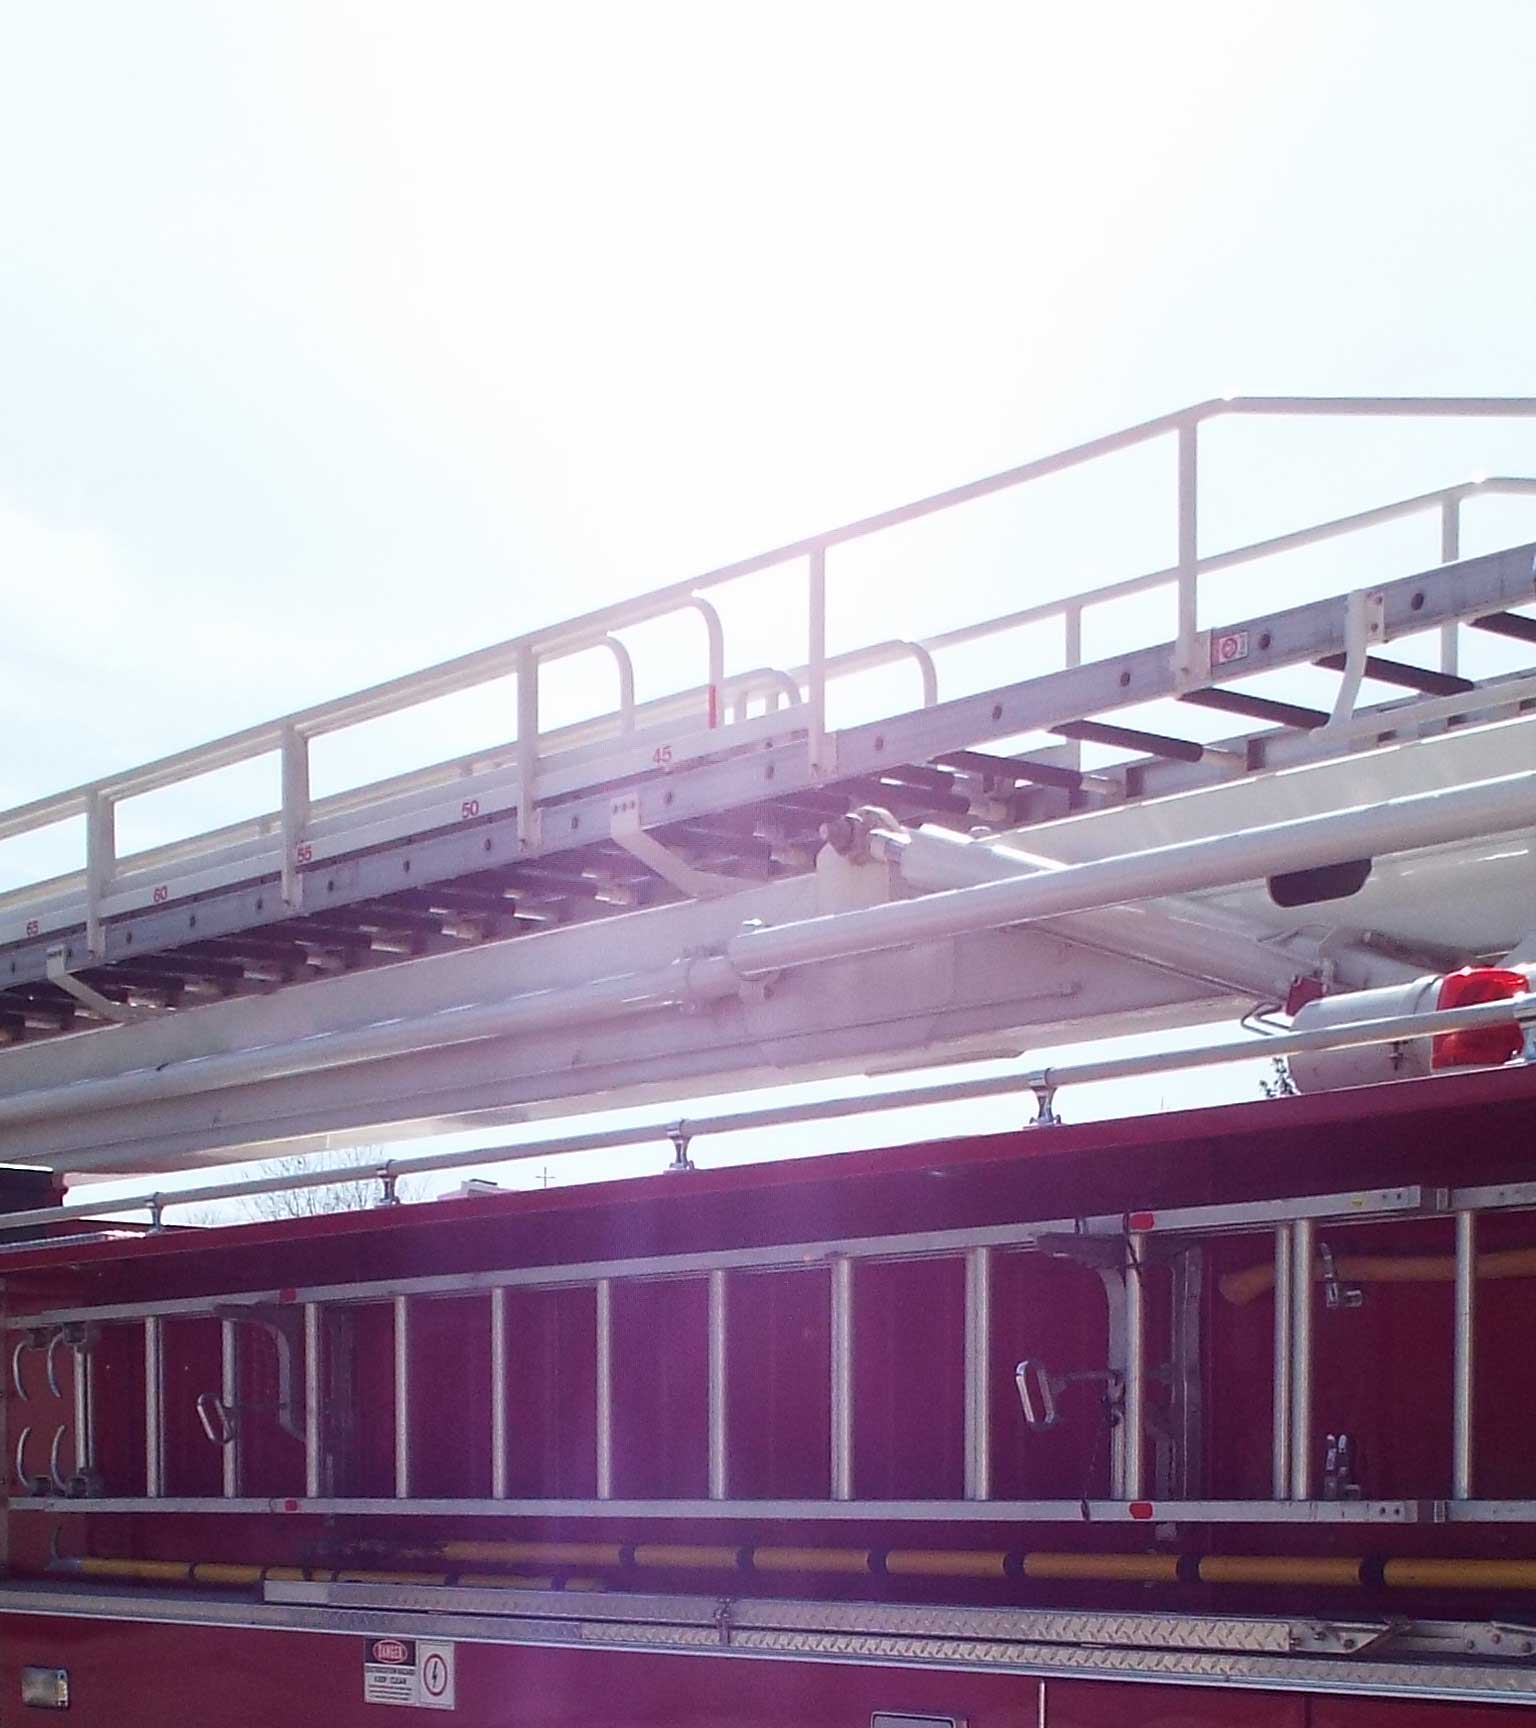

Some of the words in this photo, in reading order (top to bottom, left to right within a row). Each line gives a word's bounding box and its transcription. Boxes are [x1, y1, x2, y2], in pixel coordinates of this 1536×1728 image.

[653, 745, 672, 763] 45
[462, 800, 479, 818] 50
[297, 845, 312, 863] 55
[154, 886, 168, 902] 60
[26, 920, 39, 936] 65
